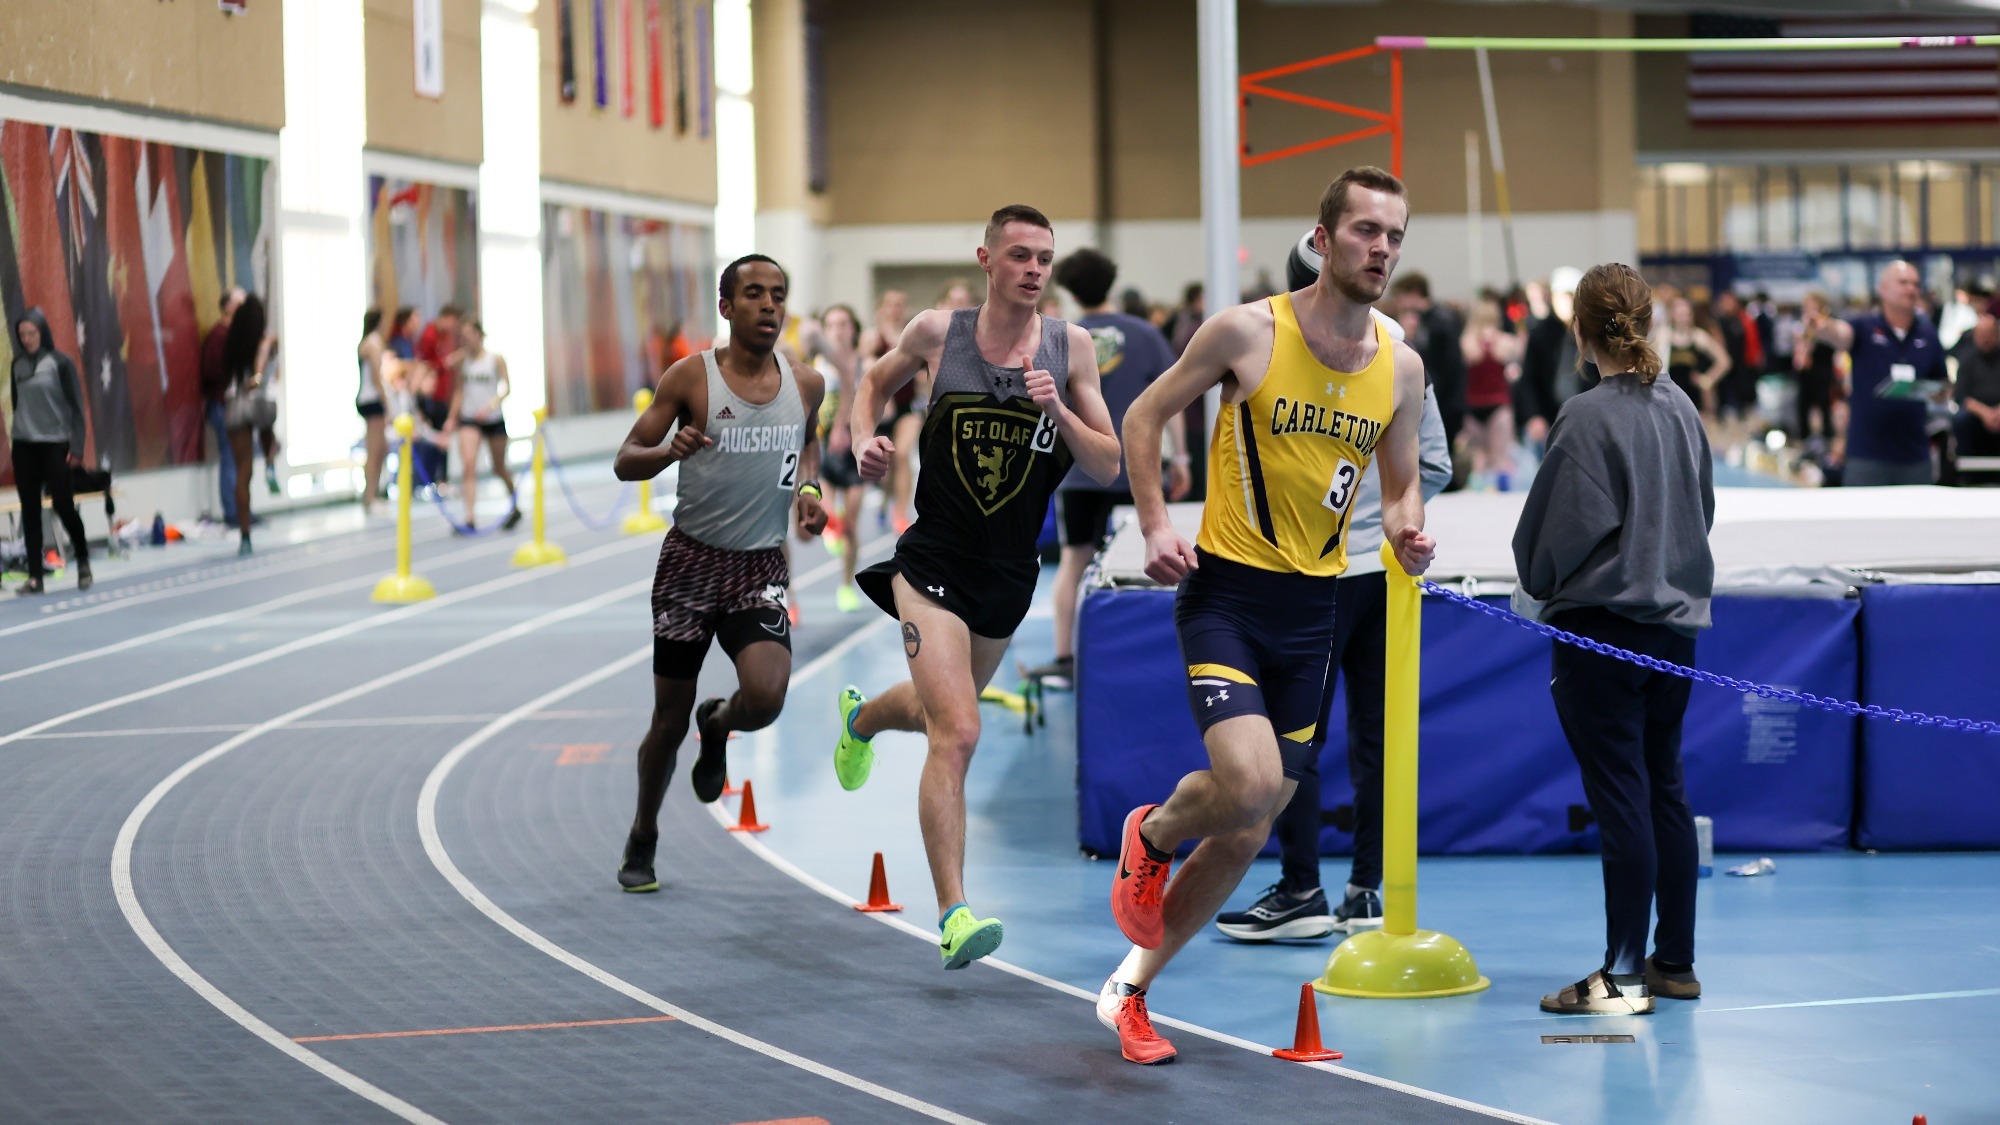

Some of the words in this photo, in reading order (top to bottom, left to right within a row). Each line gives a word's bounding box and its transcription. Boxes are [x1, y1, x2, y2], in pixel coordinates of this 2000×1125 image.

[717, 424, 799, 453] AUGSBURG
[961, 420, 985, 440] ST.
[989, 421, 1031, 446] OLAF
[1036, 416, 1056, 449] 8
[1271, 397, 1381, 457] CARLETON
[781, 453, 797, 487] 2
[1329, 465, 1355, 509] 3
